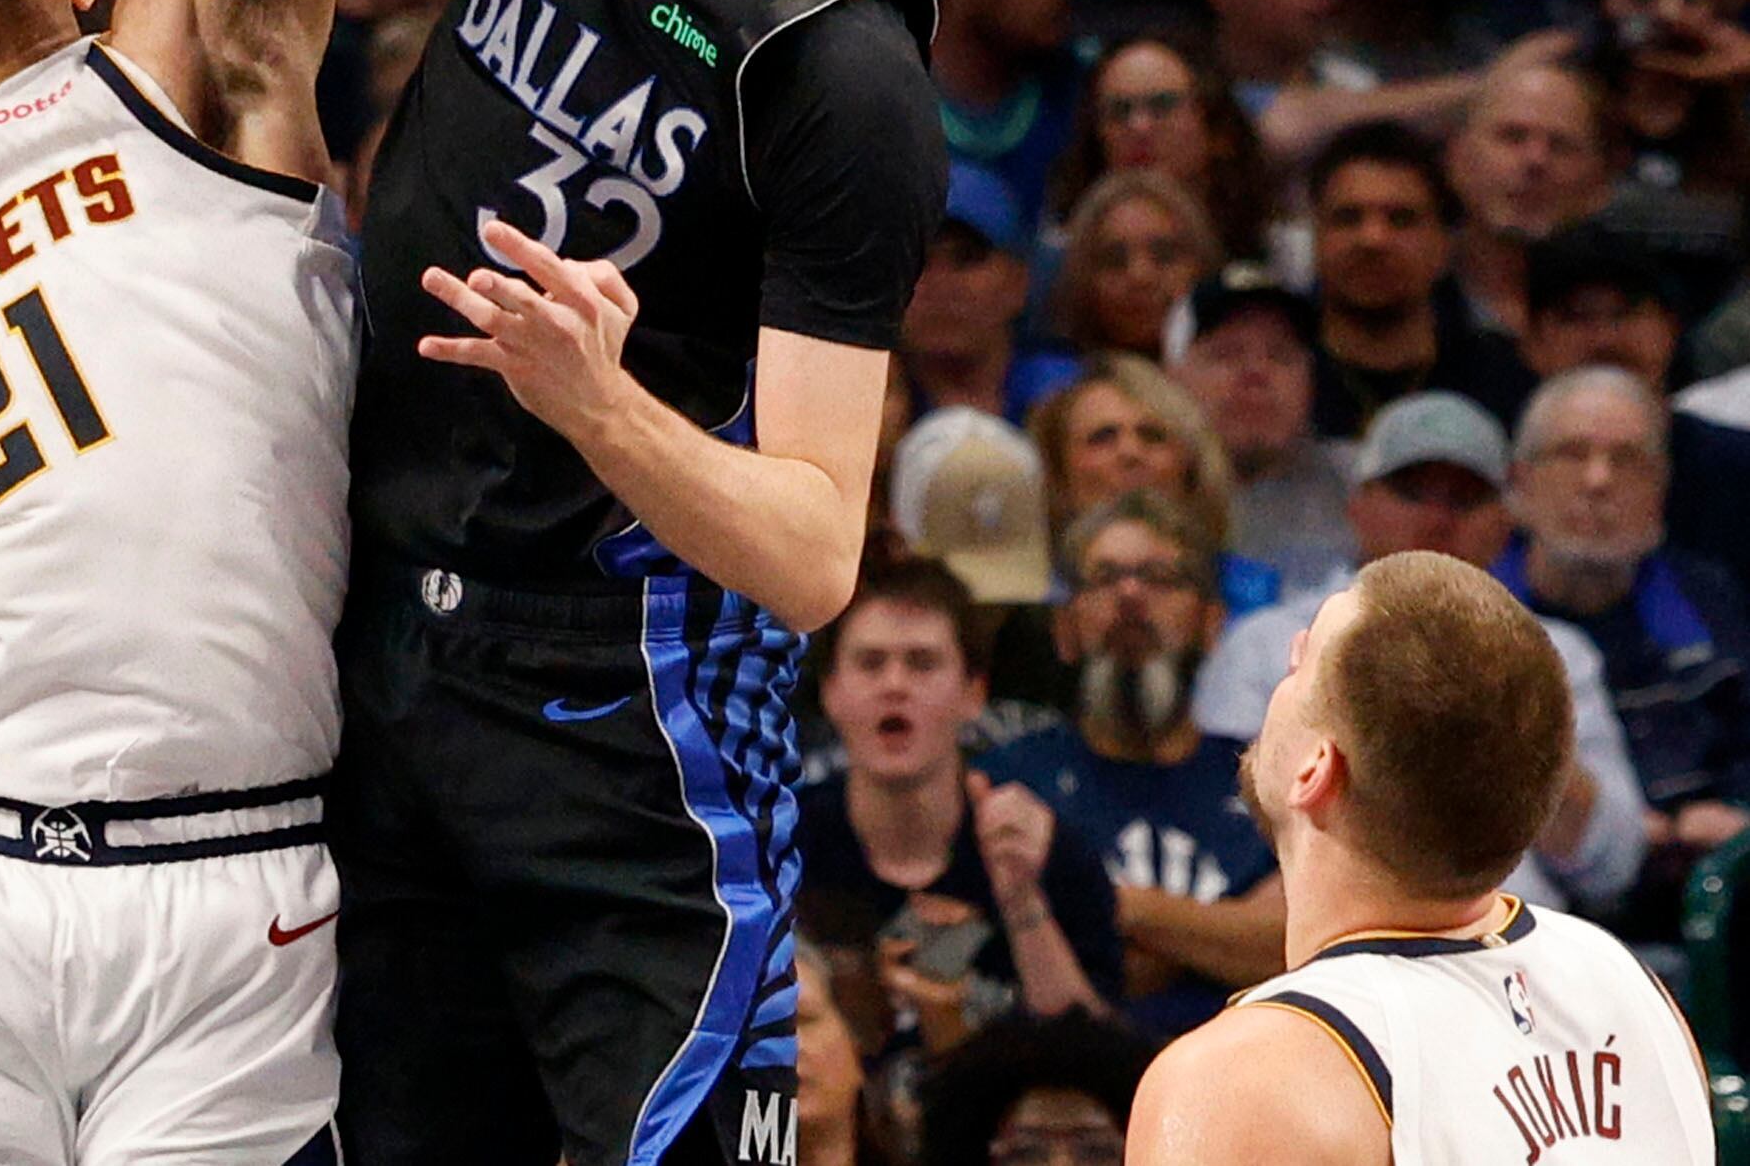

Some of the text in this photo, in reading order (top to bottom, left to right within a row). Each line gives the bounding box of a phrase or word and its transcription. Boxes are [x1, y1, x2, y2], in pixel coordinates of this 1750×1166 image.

[651, 3, 718, 68] chime
[476, 120, 663, 272] 32
[1493, 1034, 1622, 1166] JOKIĆ
